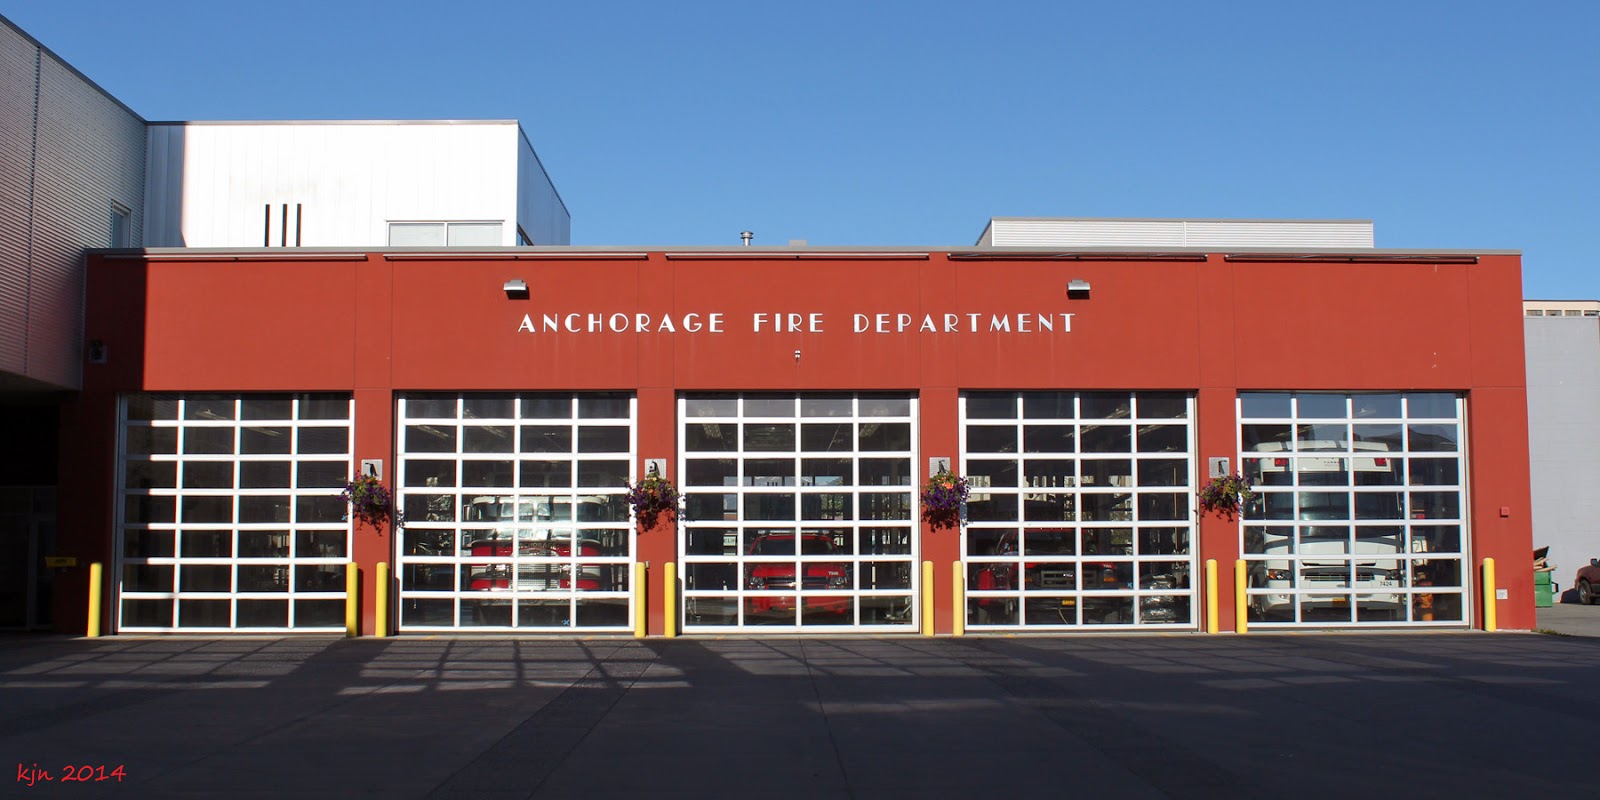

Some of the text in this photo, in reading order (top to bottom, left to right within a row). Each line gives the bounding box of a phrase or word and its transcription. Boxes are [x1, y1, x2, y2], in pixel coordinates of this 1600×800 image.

[517, 312, 1077, 333] ANCHORAGE FIRE DEPARTMENT
